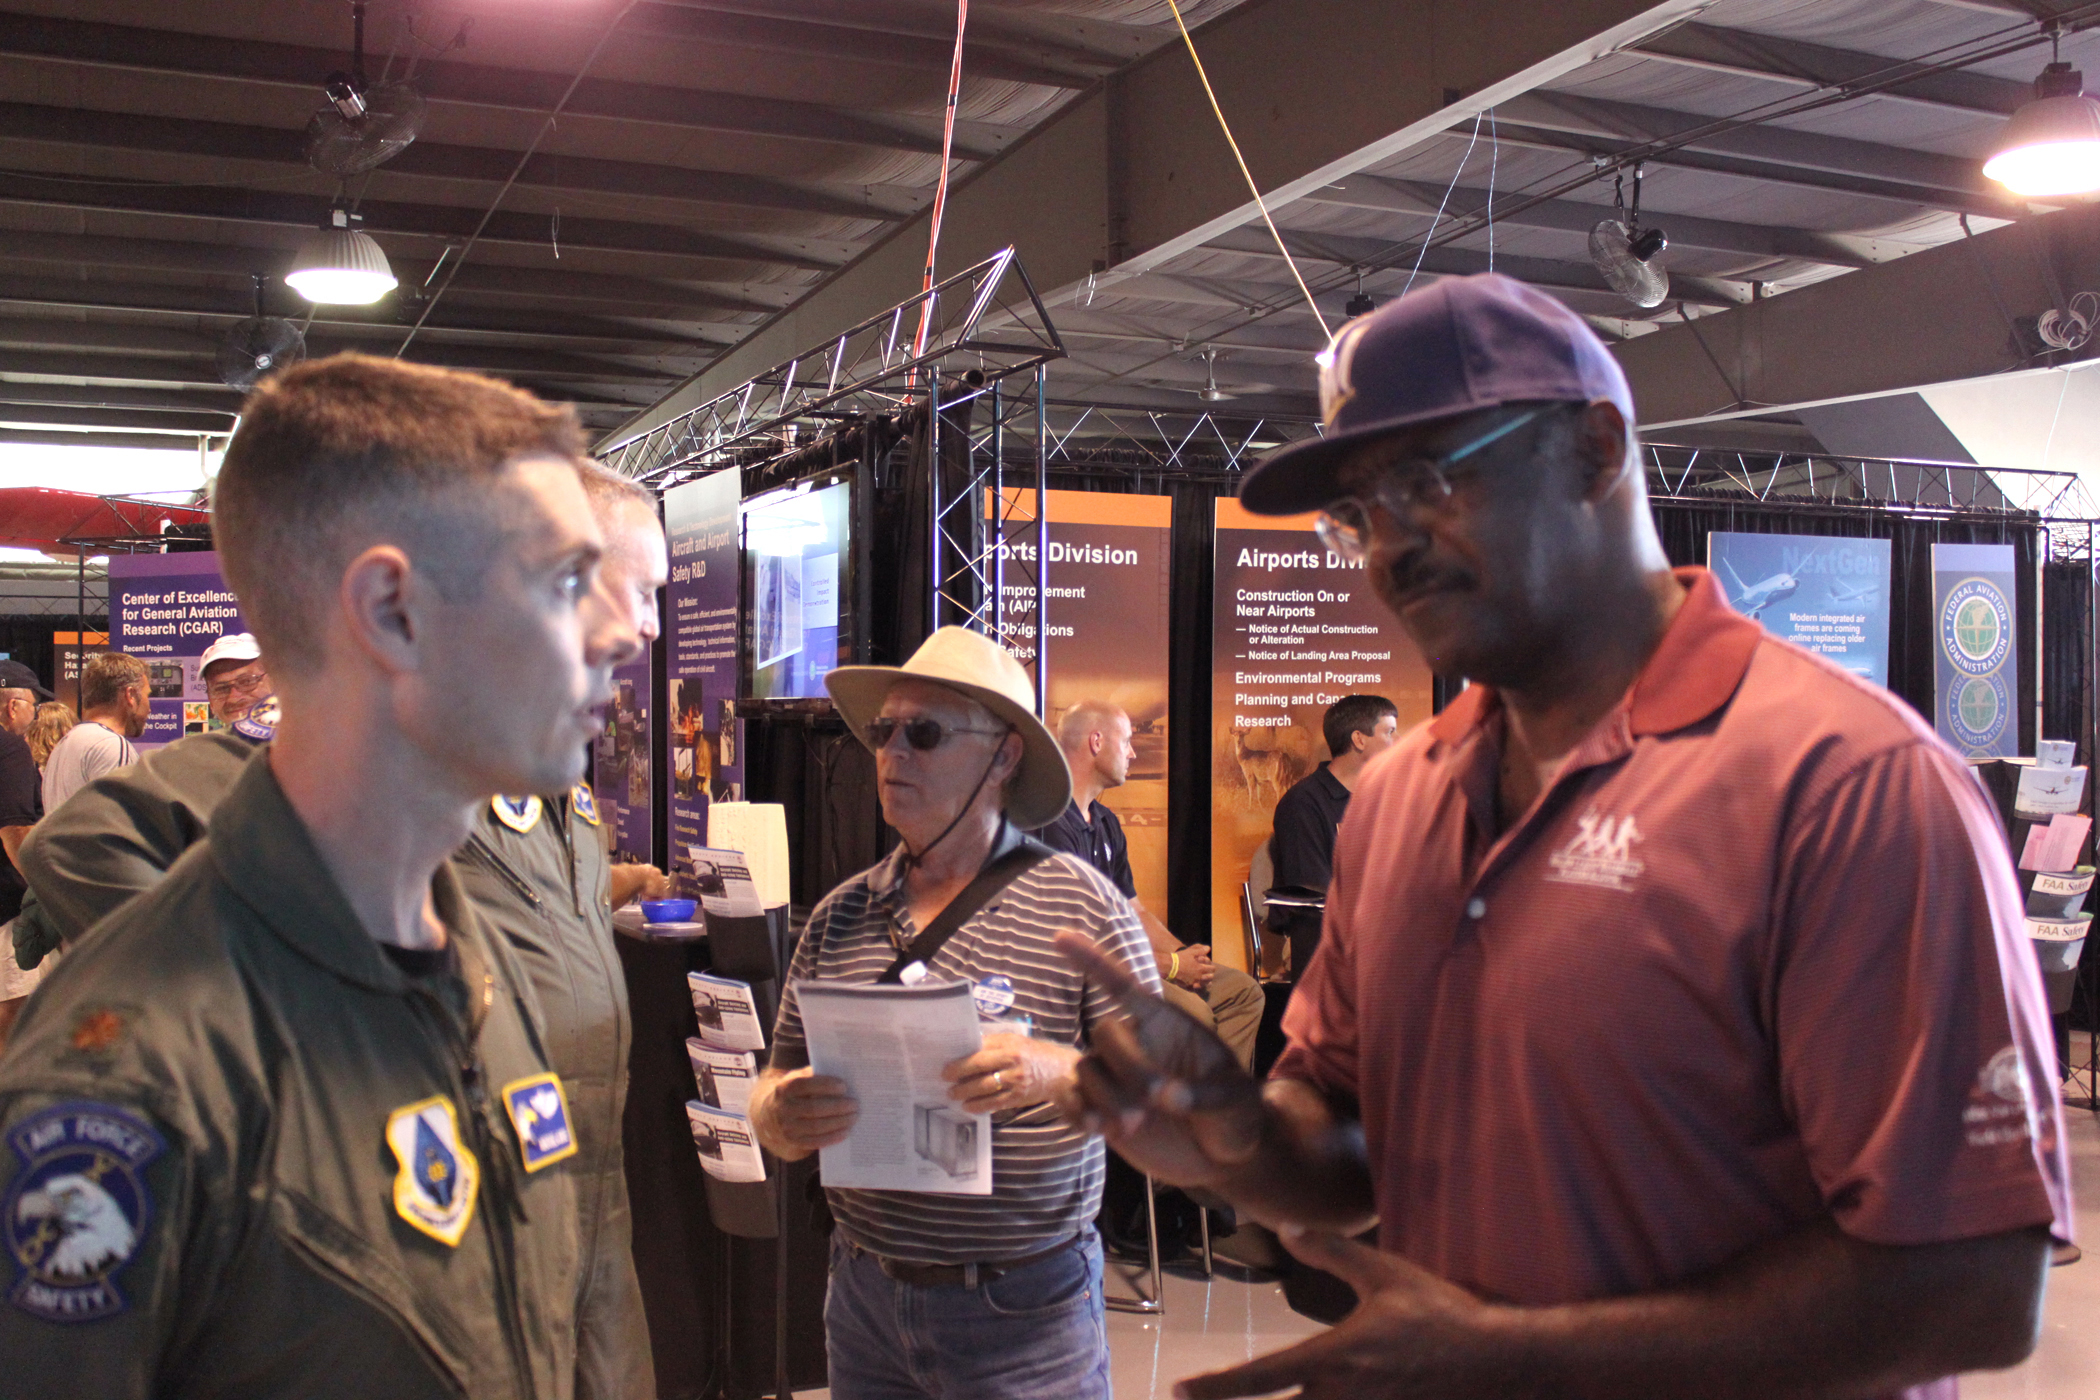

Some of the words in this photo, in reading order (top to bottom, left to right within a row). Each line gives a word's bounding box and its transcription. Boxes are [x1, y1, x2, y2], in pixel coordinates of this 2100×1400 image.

[672, 537, 694, 558] Aircraft
[695, 534, 706, 552] and
[707, 529, 730, 552] Airport
[1049, 542, 1138, 565] Division
[1237, 548, 1319, 572] Airports
[1782, 546, 1880, 575] NextGen
[672, 564, 690, 584] Safety
[692, 560, 706, 579] R&D
[122, 593, 159, 605] Center
[163, 591, 175, 604] of
[178, 590, 238, 603] Excellenc
[1001, 585, 1085, 598] mproement
[1237, 589, 1314, 602] Construction
[1317, 590, 1334, 602] On
[1338, 593, 1350, 602] or
[1946, 585, 1973, 621] FEDERAL
[1976, 585, 2007, 621] AVIATION
[122, 608, 138, 620] for
[142, 607, 186, 620] General
[189, 606, 237, 618] Aviation
[1236, 605, 1264, 616] Near
[1267, 605, 1315, 619] Airports
[1790, 613, 1817, 622] Modern
[1819, 614, 1854, 624] integrated
[1856, 614, 1865, 623] air
[123, 623, 176, 636] Research
[180, 621, 223, 636] (CGAR)
[1000, 622, 1074, 638] Obligions
[1249, 625, 1278, 634] Notice
[1280, 625, 1290, 634] of
[1291, 625, 1319, 634] Actual
[1322, 625, 1378, 634] Construction
[1794, 623, 1819, 632] frames
[1834, 625, 1860, 634] coming
[1261, 636, 1304, 644] Alteration
[1813, 634, 1846, 644] replacing
[147, 644, 173, 653] Projects
[1811, 644, 1821, 652] air
[1823, 644, 1847, 652] frames
[1946, 637, 2008, 672] ADMINISTRATION
[1249, 651, 1278, 660] Notice
[1280, 651, 1290, 660] of
[1291, 651, 1327, 661] Landing
[1329, 652, 1349, 660] Area
[1351, 651, 1390, 661] Proposal
[1236, 672, 1321, 684] Environmental
[1325, 672, 1381, 685] Programs
[1236, 694, 1288, 707] Planning
[1291, 693, 1313, 705] and
[154, 722, 177, 731] Cockpit
[1236, 715, 1291, 727] Research
[2042, 879, 2064, 890] FAA
[2037, 925, 2059, 936] FAA
